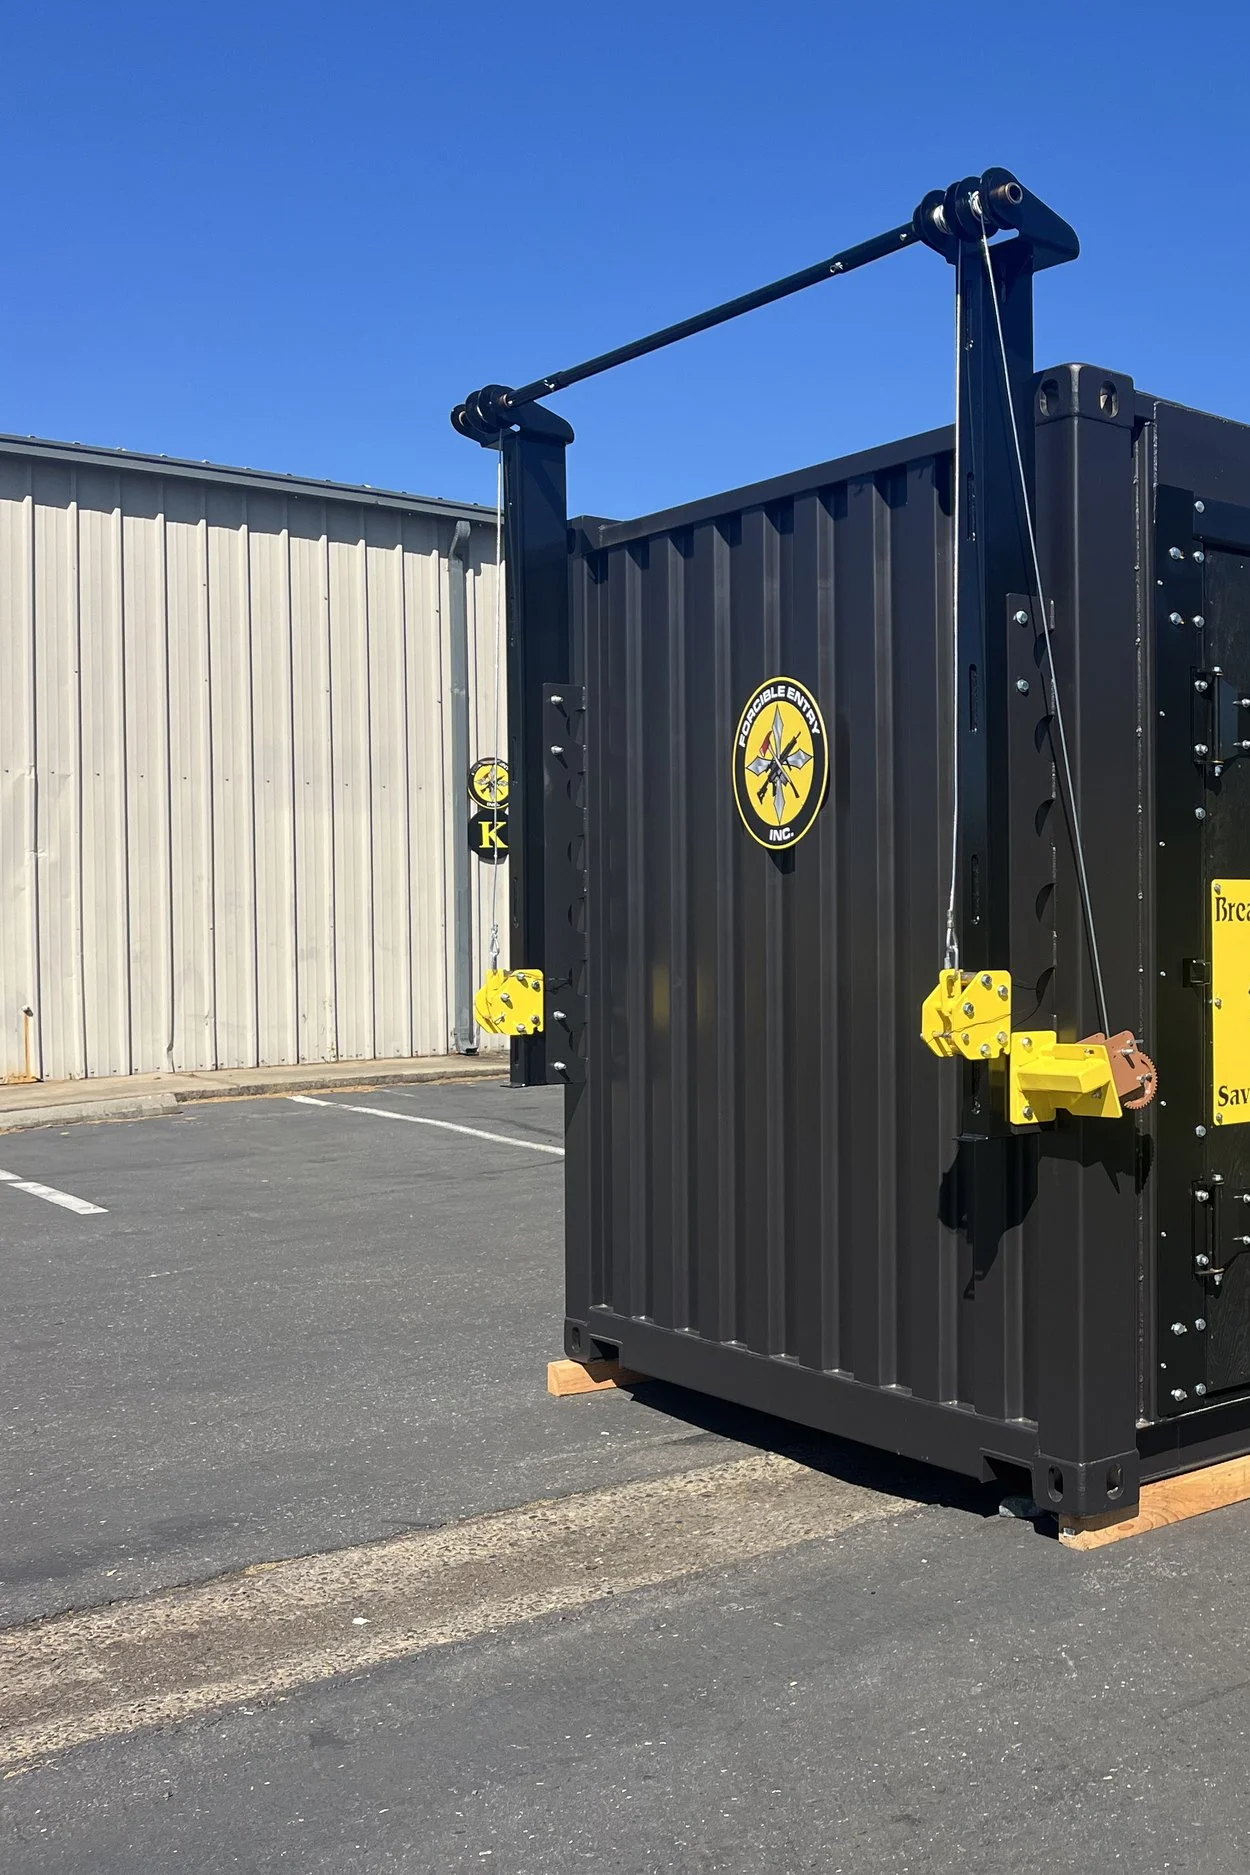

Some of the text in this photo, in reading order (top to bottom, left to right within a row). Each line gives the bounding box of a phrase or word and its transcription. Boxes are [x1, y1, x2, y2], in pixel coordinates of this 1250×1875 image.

[738, 685, 821, 748] FORCIBLE ENTRY
[478, 821, 509, 848] K
[769, 827, 795, 842] INC.
